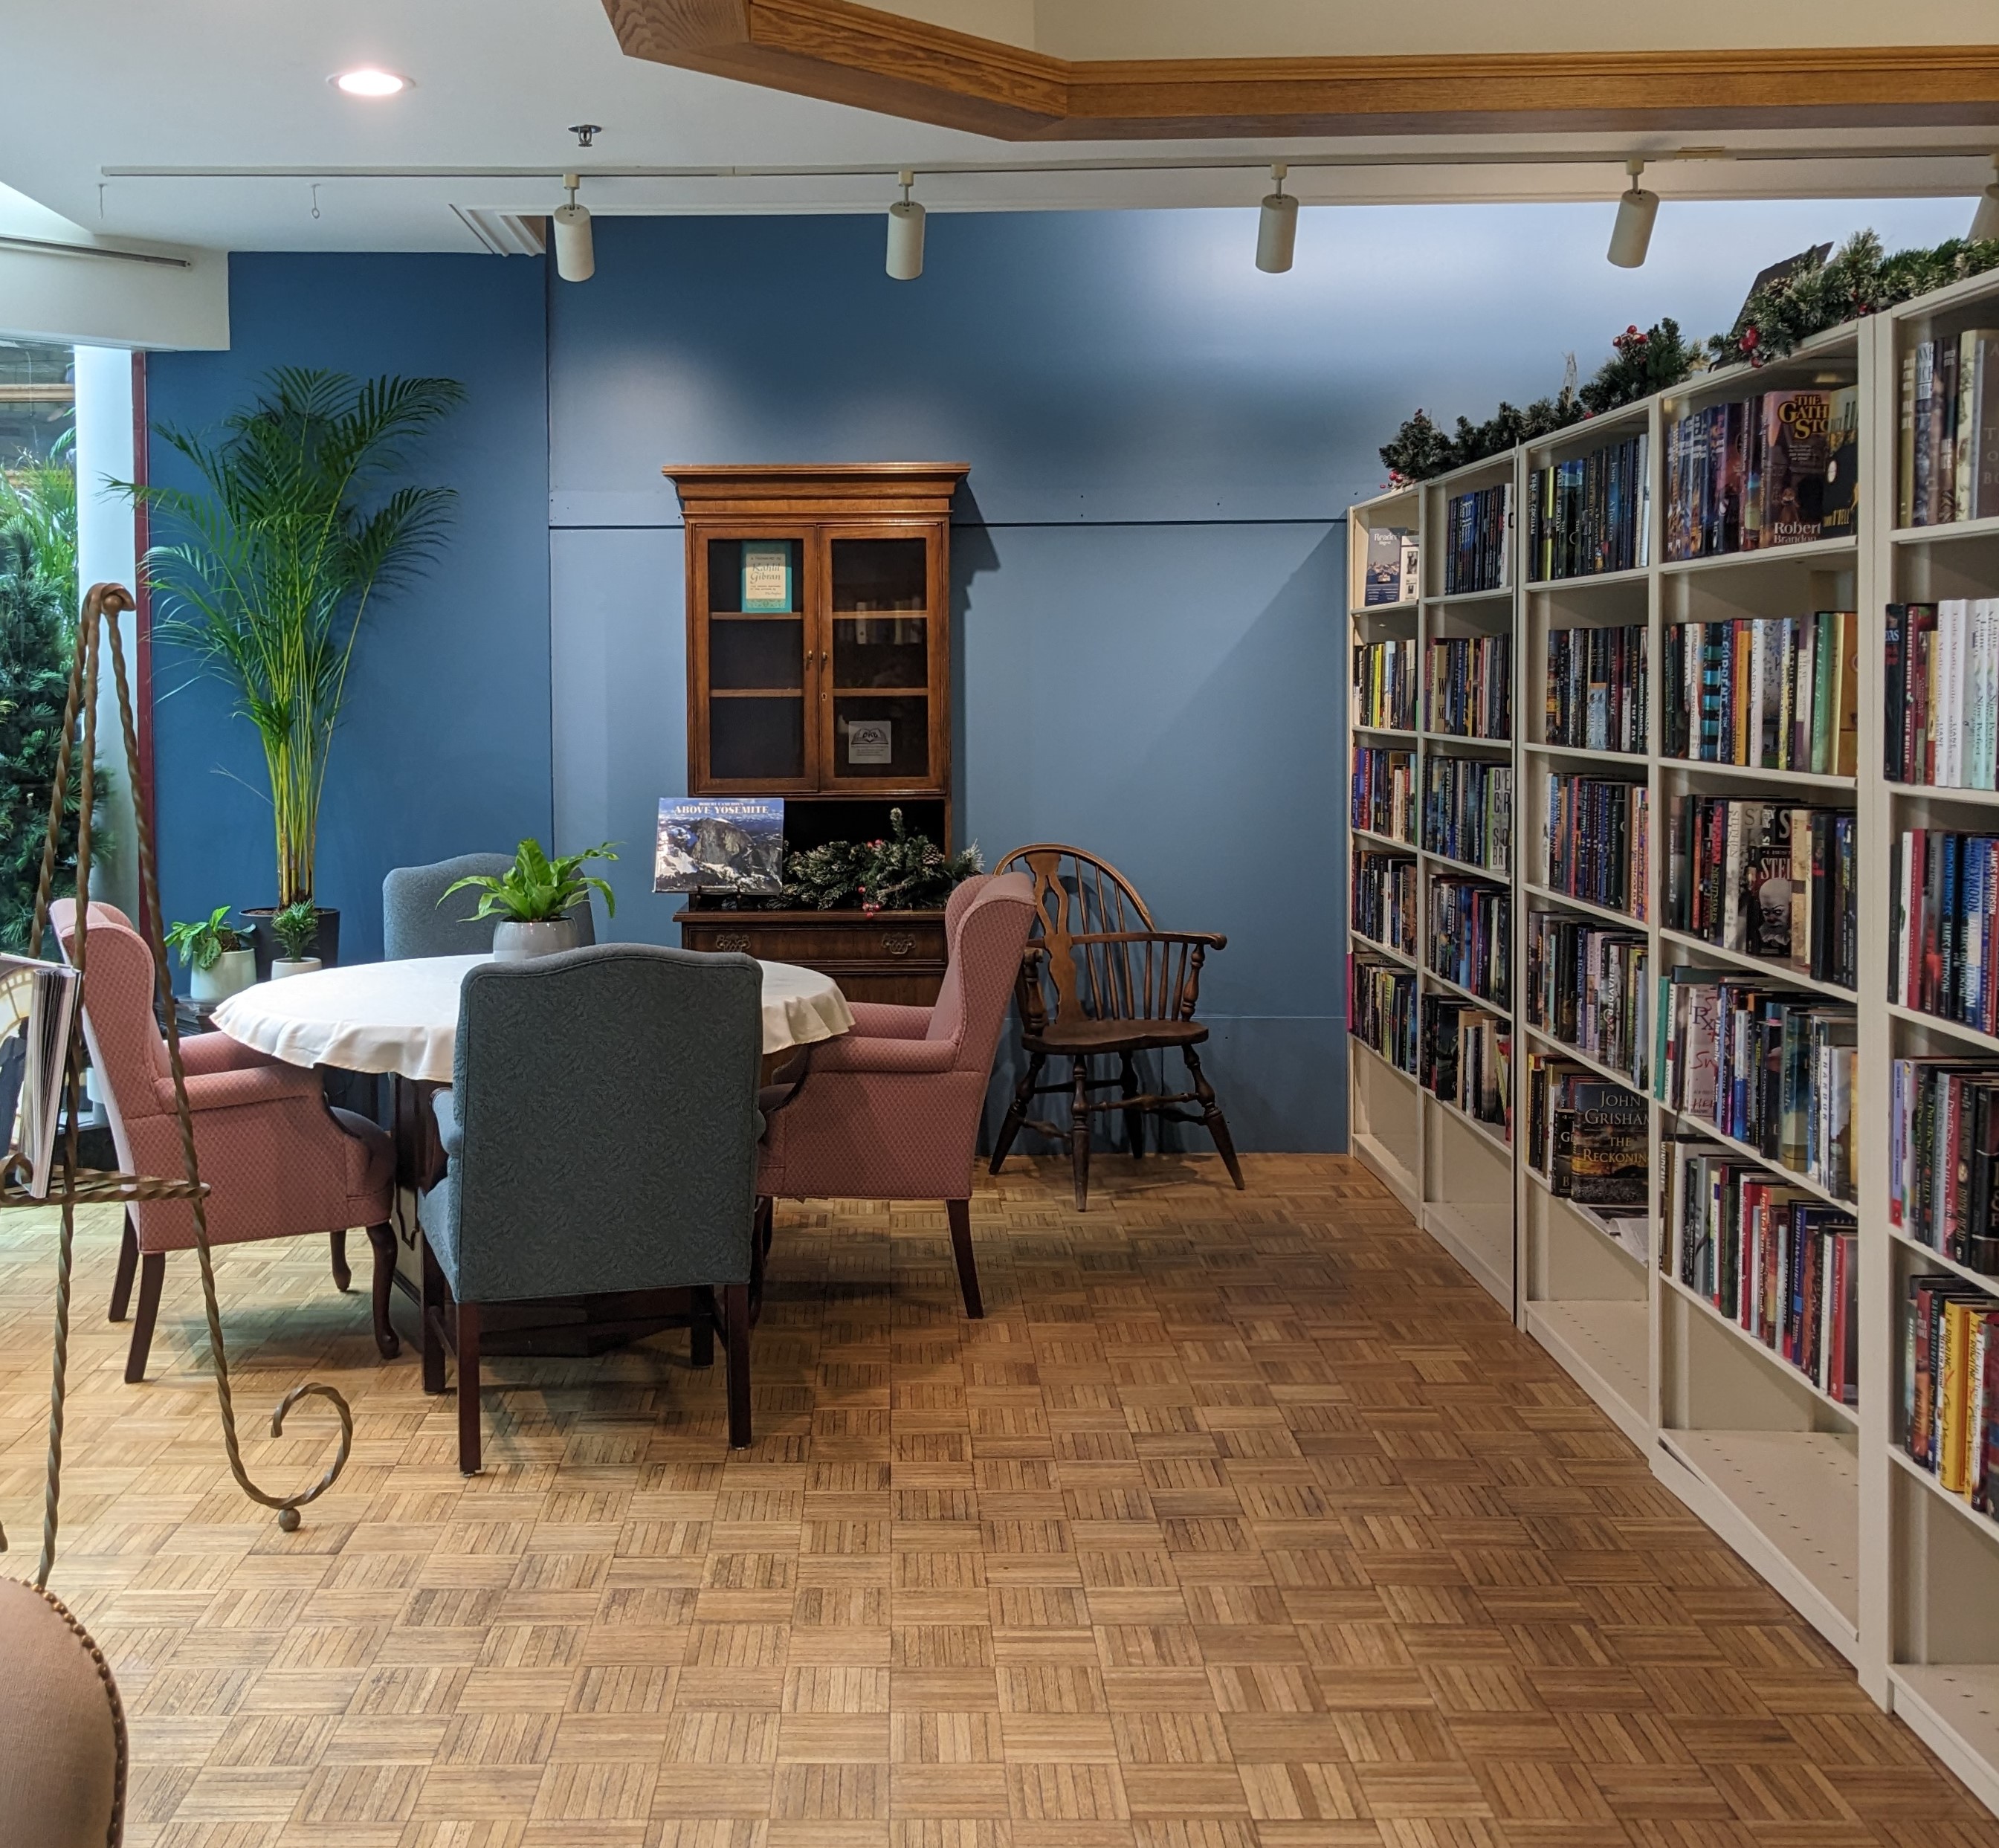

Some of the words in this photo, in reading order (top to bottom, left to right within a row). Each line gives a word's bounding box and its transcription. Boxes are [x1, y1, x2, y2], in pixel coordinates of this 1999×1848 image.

[1796, 395, 1821, 406] THE
[1778, 401, 1830, 424] GATH
[1609, 462, 1618, 483] JOHN
[1774, 521, 1821, 534] Robert
[750, 572, 781, 584] Gibran
[752, 563, 781, 572] Kahlil
[1722, 642, 1730, 705] CURRENT
[1815, 627, 1824, 701] TRUST
[1989, 696, 1997, 718] Nine
[675, 806, 710, 814] ABOVE
[714, 806, 769, 814] YOSEMITE
[1732, 810, 1740, 857] STEPHEN
[1991, 850, 1999, 873] JAMES
[1711, 865, 1719, 923] NIGHTMARES
[1989, 874, 1998, 915] PATTERSON
[1943, 922, 1951, 946] JAMES
[1941, 948, 1951, 993] PATTERSON
[1601, 1091, 1641, 1108] JOHN
[1926, 1105, 1934, 1151] PRESTON
[1609, 1137, 1631, 1147] THE
[1957, 1187, 1968, 1213] BOOK
[1956, 1216, 1967, 1241] DEAD
[1944, 1328, 1952, 1370] ROWLING
